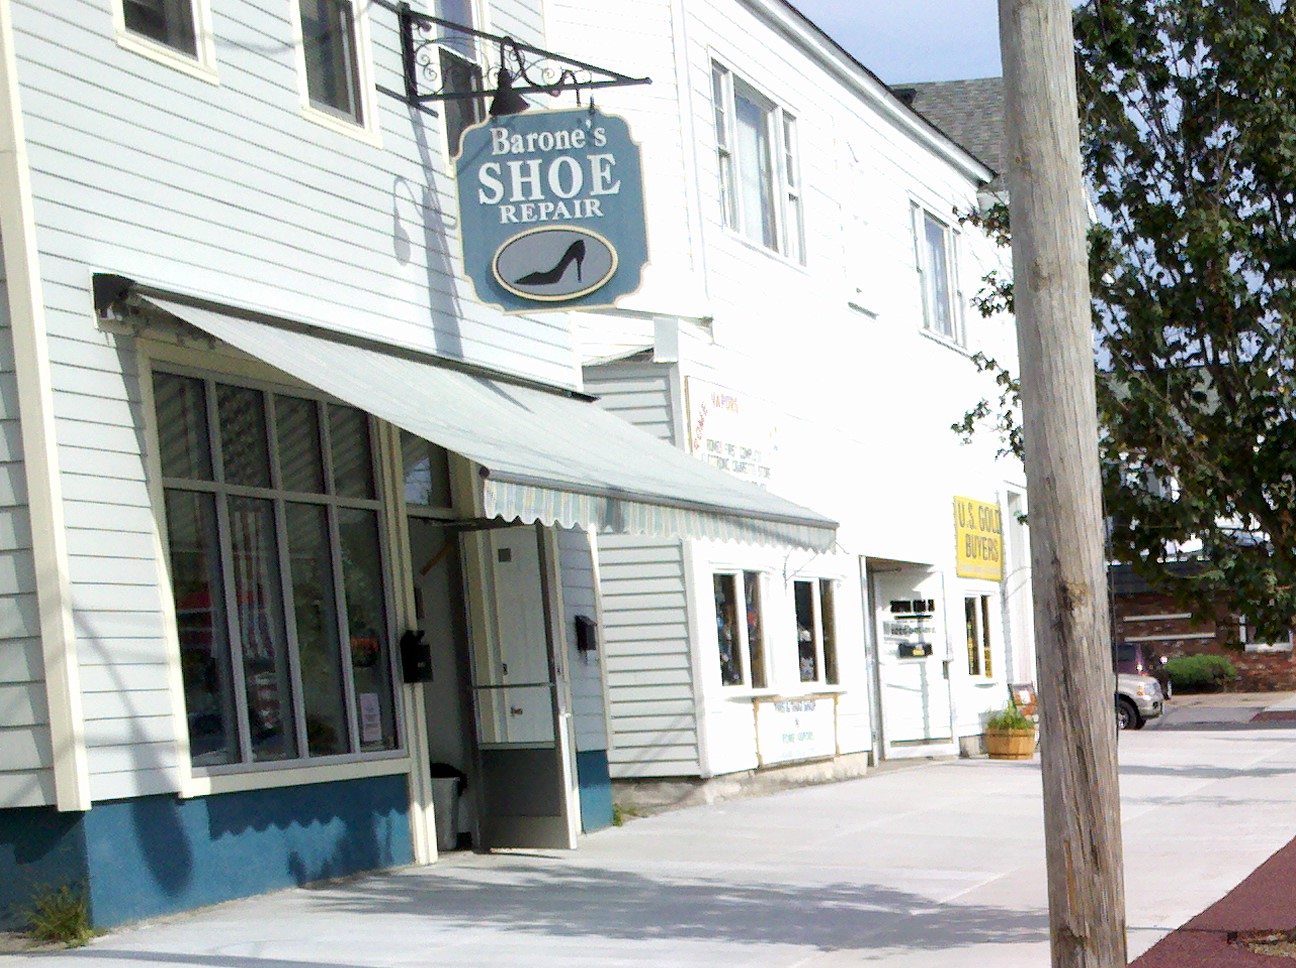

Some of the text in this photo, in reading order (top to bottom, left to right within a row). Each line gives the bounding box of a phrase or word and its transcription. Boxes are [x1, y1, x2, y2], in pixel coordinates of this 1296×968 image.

[489, 118, 608, 156] Barone's
[478, 153, 621, 205] SHOE
[499, 199, 605, 224] REPAIR
[965, 533, 999, 562] BUYERS
